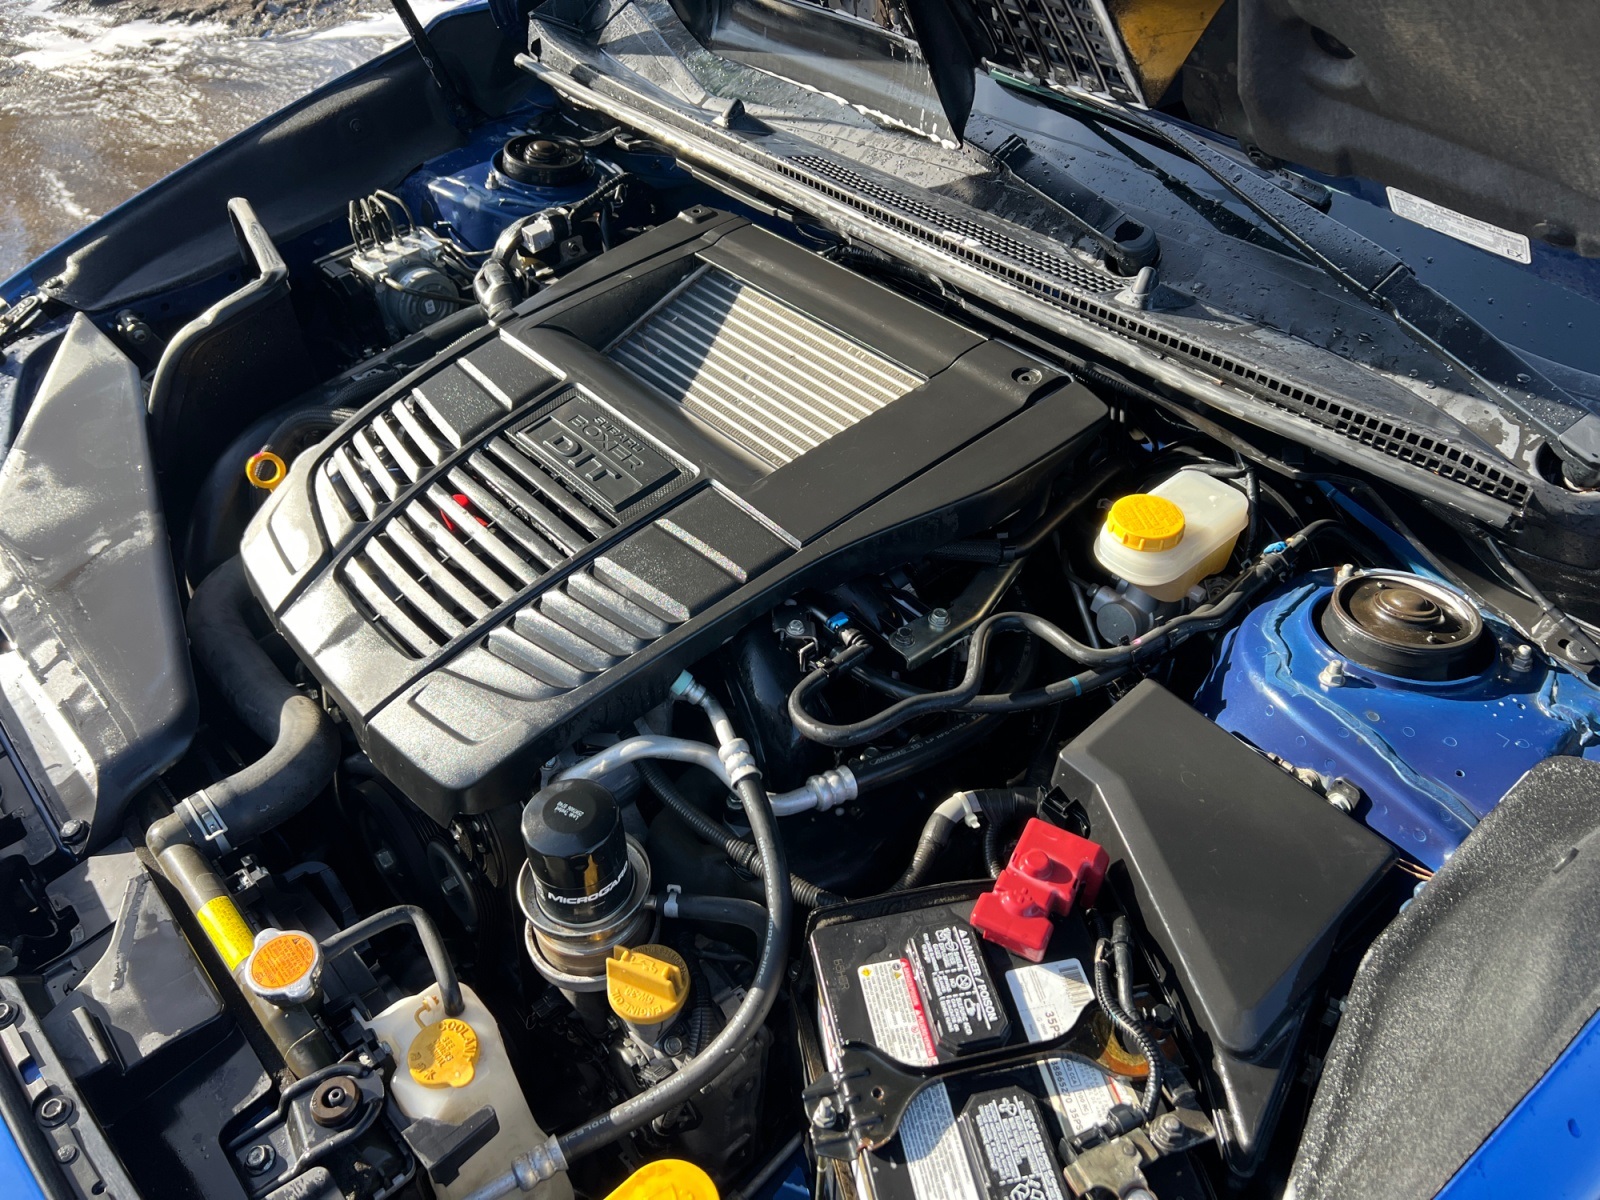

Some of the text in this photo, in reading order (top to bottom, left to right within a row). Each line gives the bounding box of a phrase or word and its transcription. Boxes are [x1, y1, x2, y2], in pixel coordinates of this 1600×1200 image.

[1507, 249, 1524, 259] EX
[569, 414, 644, 471] BOXER
[593, 415, 645, 453] SUBARU
[543, 433, 622, 482] DIT
[961, 937, 981, 977] DANGER
[977, 983, 997, 1021] POISON
[612, 988, 663, 1016] ENGINE OIL
[438, 1021, 476, 1062] COOLANT
[1069, 1071, 1078, 1084] CCA
[1069, 1108, 1084, 1130] 35PS
